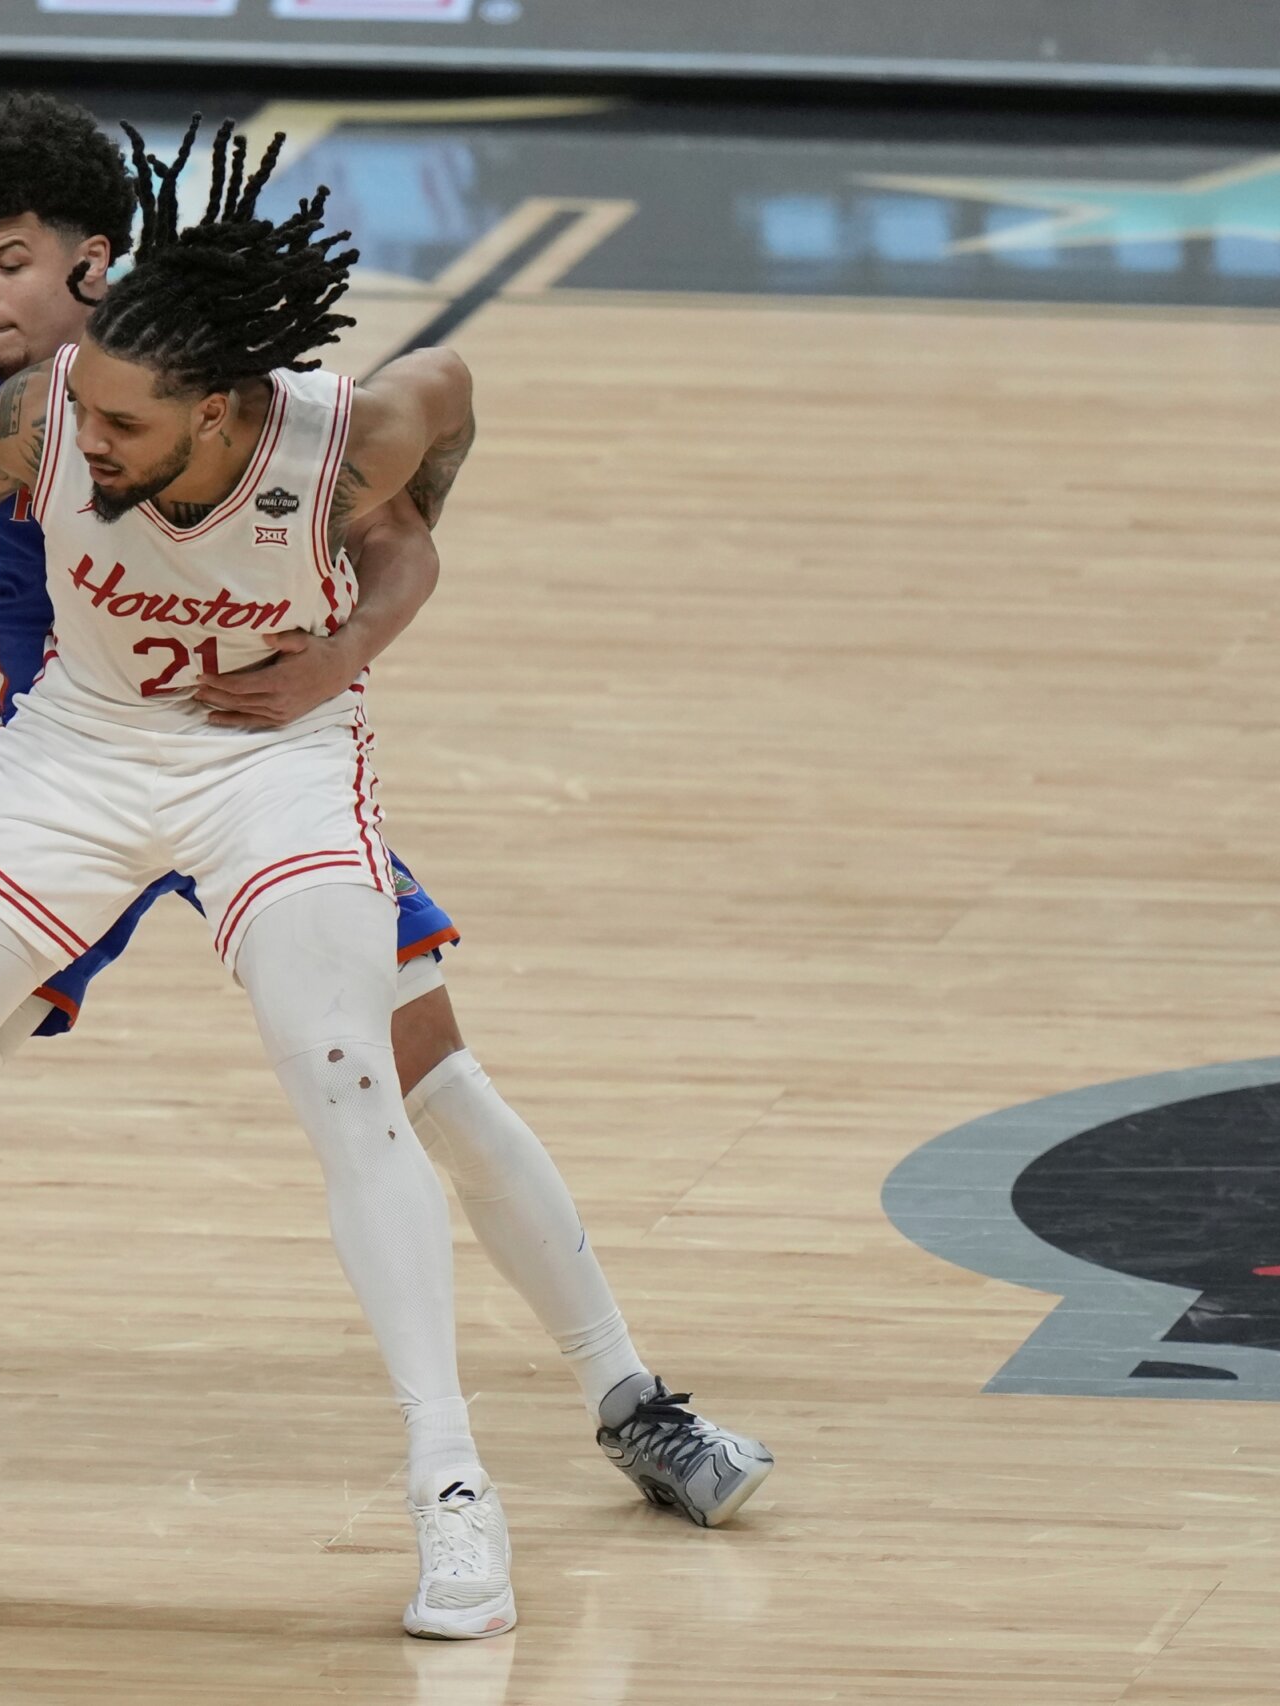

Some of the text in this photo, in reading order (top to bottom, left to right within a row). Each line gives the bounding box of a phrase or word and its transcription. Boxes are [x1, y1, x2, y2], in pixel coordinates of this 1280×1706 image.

[257, 498, 298, 508] FINAL FOUR
[67, 553, 292, 631] Houston
[132, 636, 220, 698] 21
